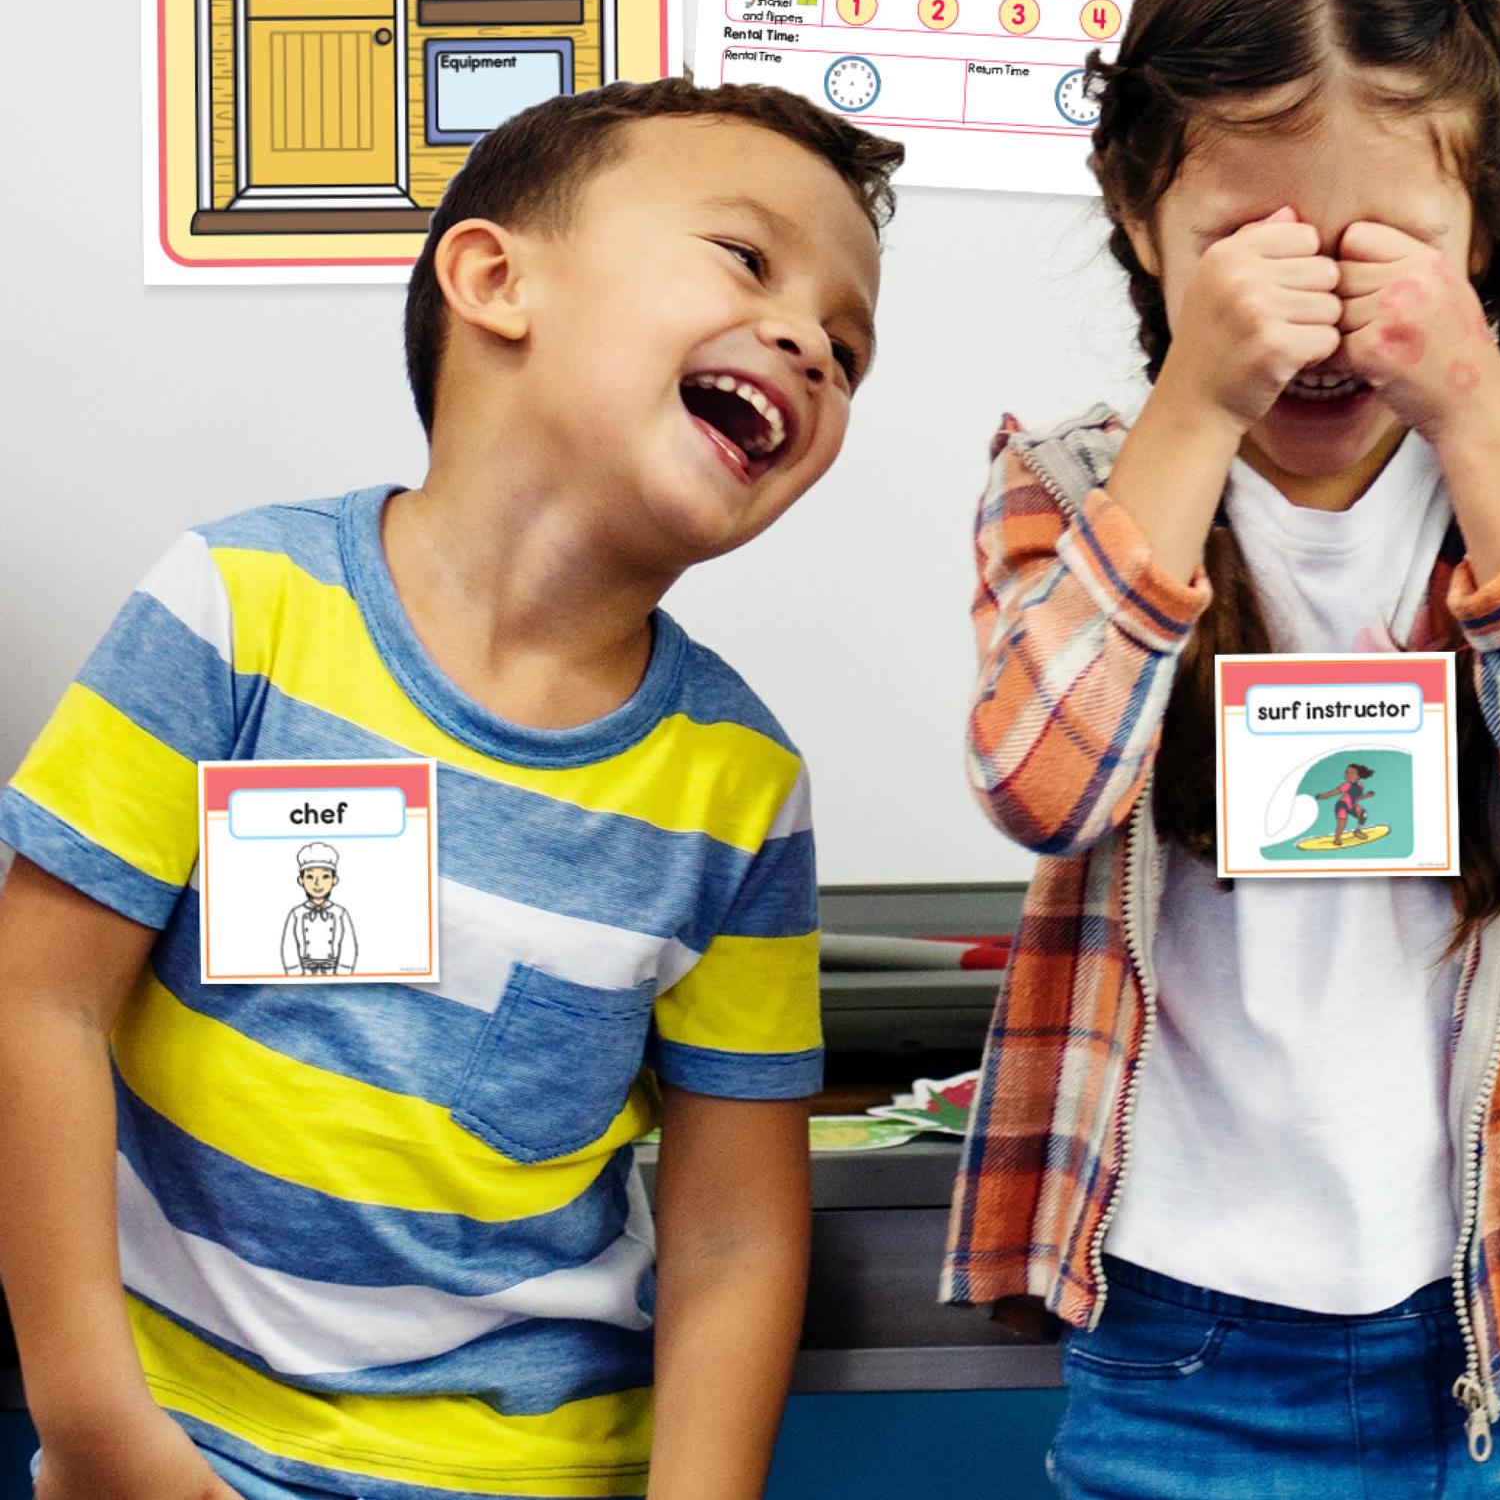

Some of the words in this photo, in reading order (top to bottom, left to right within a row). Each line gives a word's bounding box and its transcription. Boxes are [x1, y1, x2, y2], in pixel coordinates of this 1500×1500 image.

[742, 10, 764, 23] and
[766, 10, 804, 24] flippers
[723, 26, 763, 41] Rental
[766, 29, 799, 43] Time:
[441, 55, 517, 72] Equipment
[724, 49, 758, 61] Rental
[758, 51, 782, 63] Time
[967, 62, 1004, 75] Return
[1004, 64, 1031, 76] Time
[1257, 700, 1302, 721] surf
[1305, 700, 1411, 720] instructor
[289, 801, 349, 825] chef
